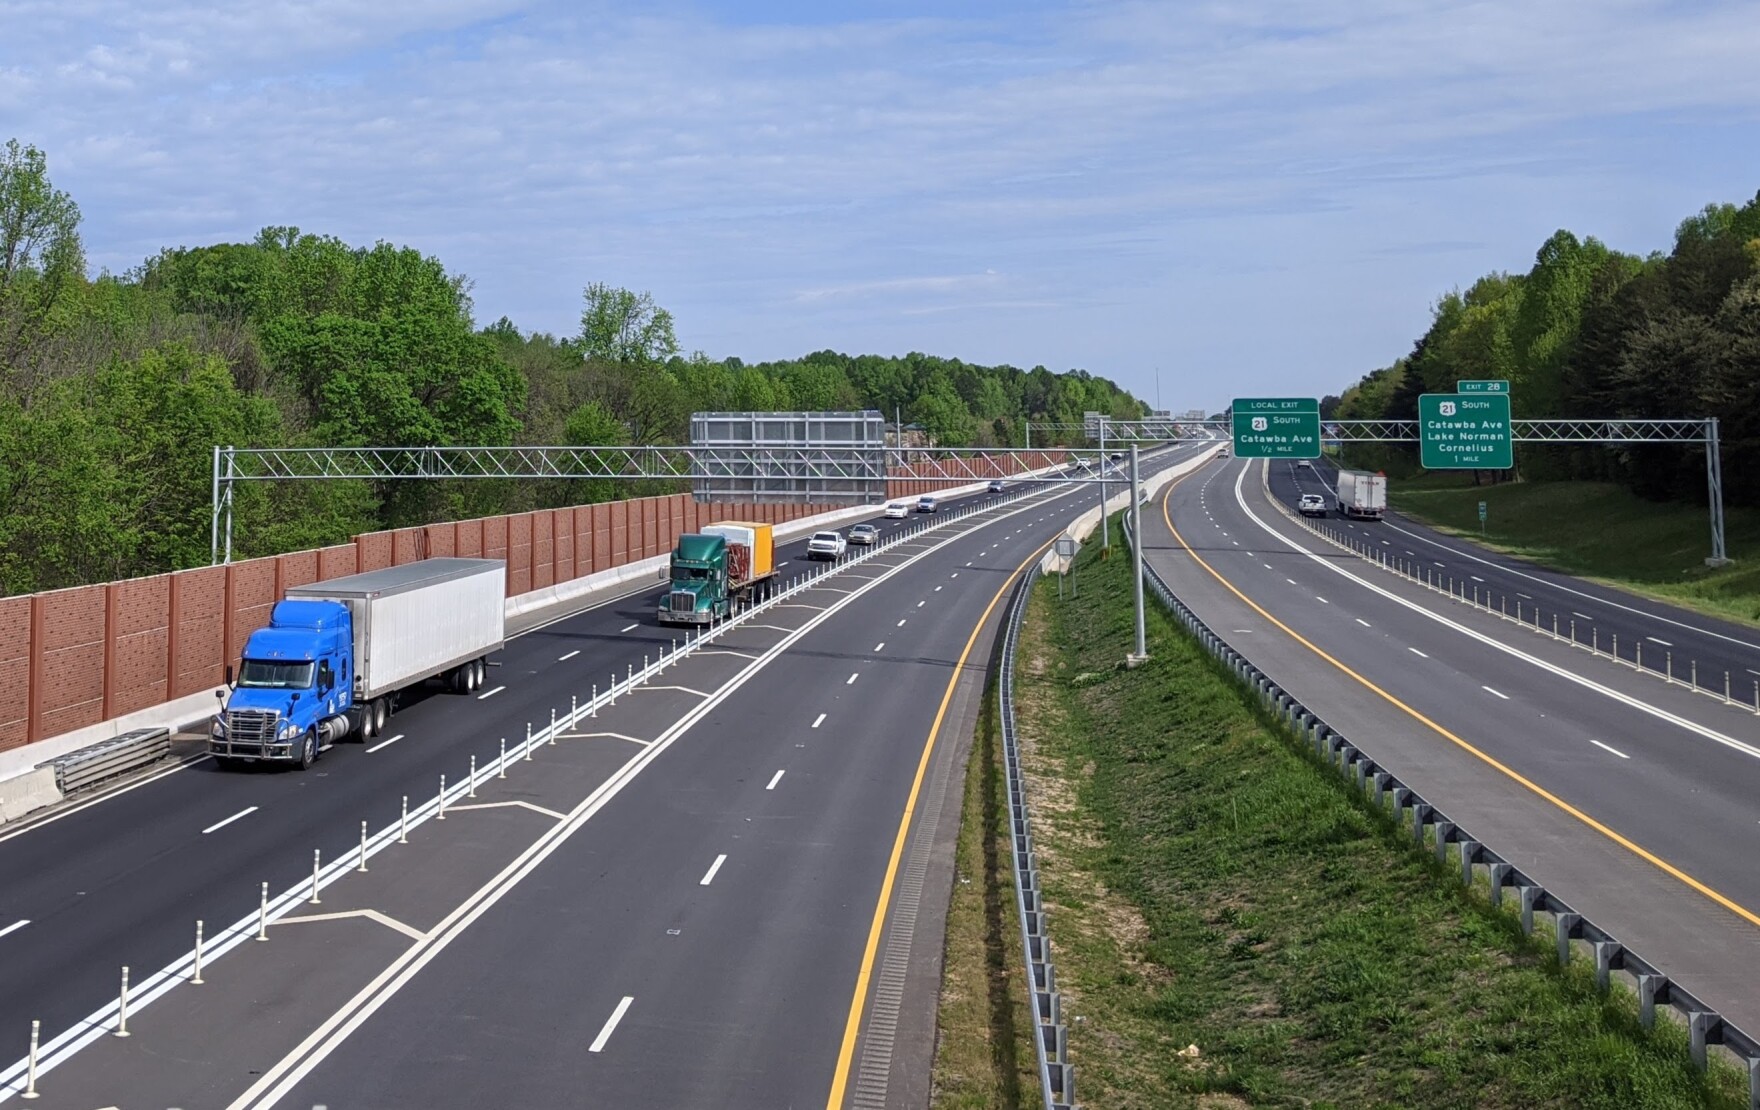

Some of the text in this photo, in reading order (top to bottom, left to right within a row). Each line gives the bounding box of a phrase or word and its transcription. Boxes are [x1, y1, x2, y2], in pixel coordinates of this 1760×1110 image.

[1487, 383, 1501, 391] 28
[1442, 404, 1453, 414] 21
[1254, 420, 1265, 429] 21
[1428, 420, 1503, 429] Catawba Ave
[1240, 434, 1313, 443] Catawba Ave
[1428, 432, 1504, 440] Lake Norman
[1438, 444, 1494, 452] Cornelius
